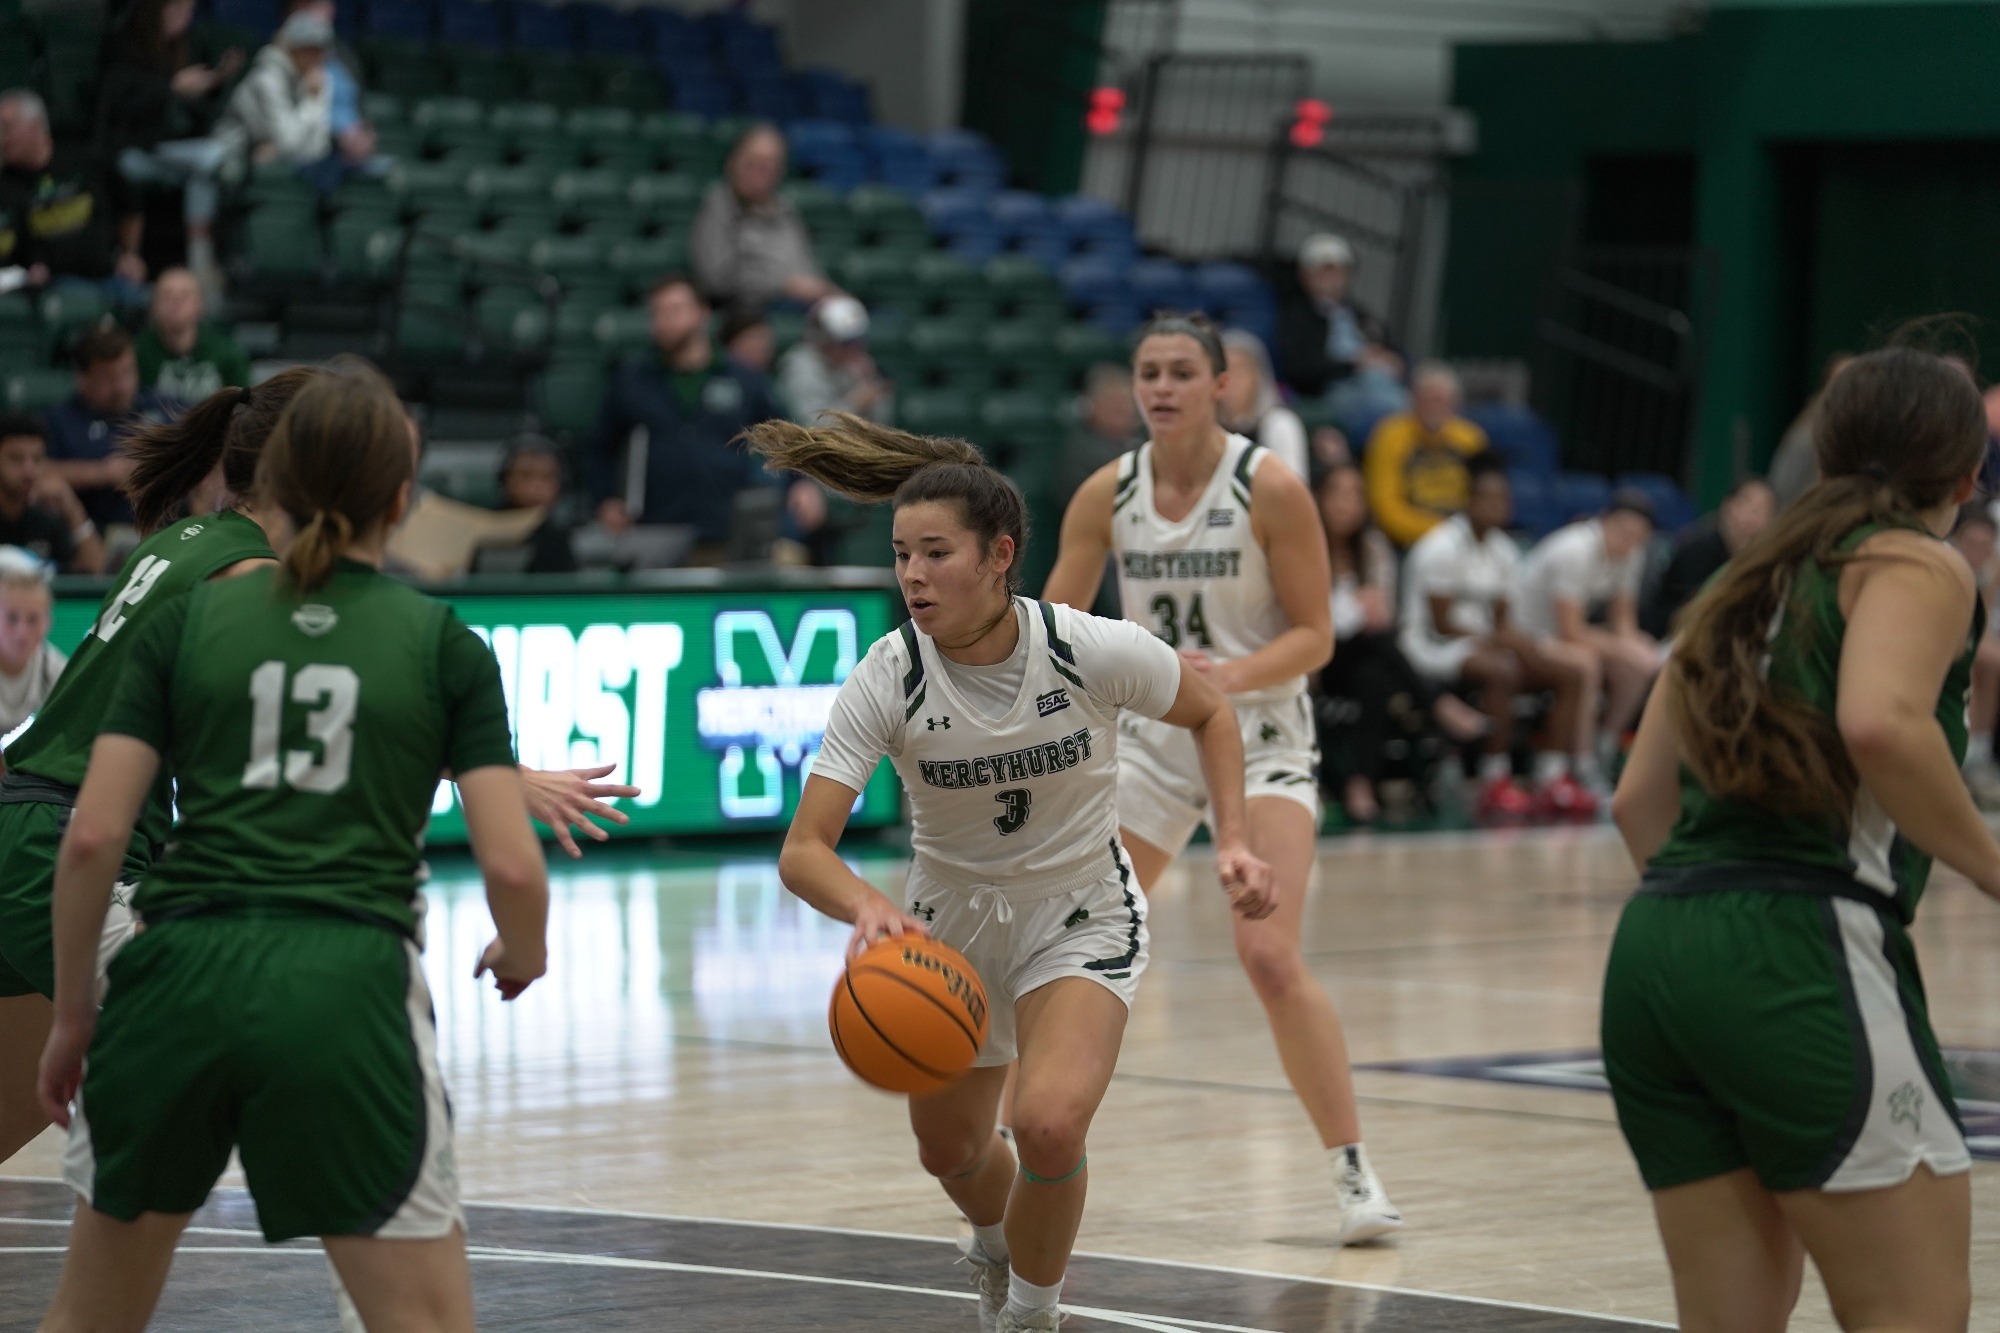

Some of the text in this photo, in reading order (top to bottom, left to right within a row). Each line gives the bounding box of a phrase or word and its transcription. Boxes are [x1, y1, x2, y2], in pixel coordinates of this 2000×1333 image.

[1150, 591, 1214, 648] 34
[241, 660, 360, 794] 13
[1037, 692, 1070, 713] PSAC
[918, 727, 1092, 789] MERCYHURST
[993, 788, 1032, 836] 3
